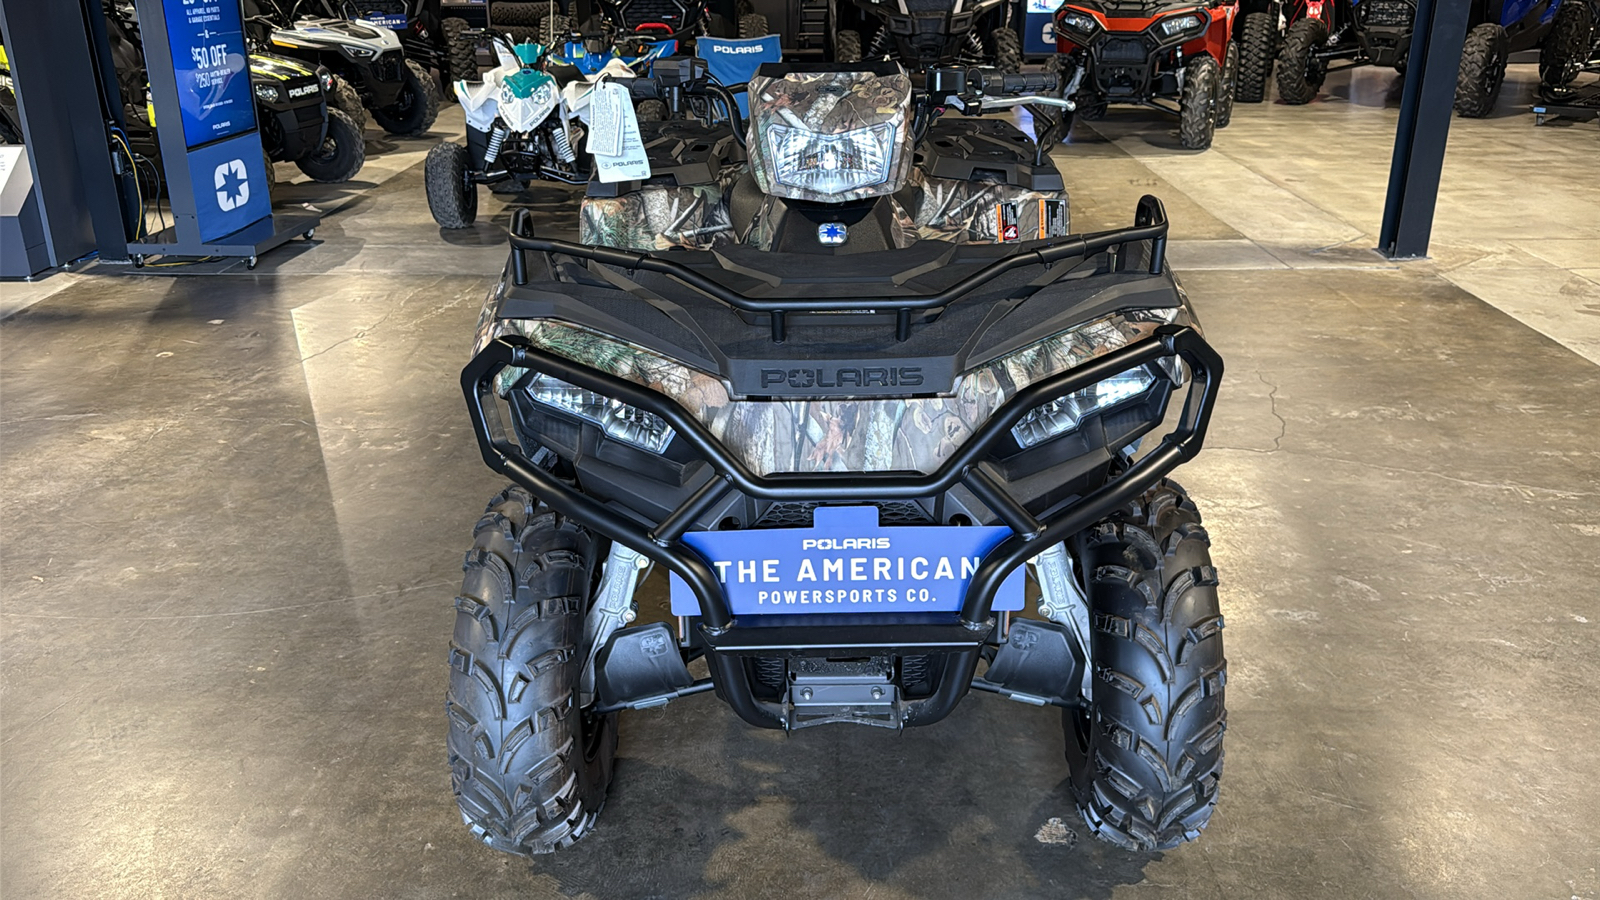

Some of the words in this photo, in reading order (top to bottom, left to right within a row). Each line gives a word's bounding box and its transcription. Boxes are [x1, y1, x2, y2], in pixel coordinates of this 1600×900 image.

[191, 45, 209, 69] $50
[210, 43, 227, 67] OFF
[713, 44, 764, 54] POLARIS
[288, 83, 319, 98] POLARIS
[612, 160, 644, 168] POLARIS
[760, 367, 924, 389] POLARIS
[802, 537, 891, 550] POLARIS
[714, 559, 781, 584] THE
[796, 556, 981, 582] AMERICAN
[758, 588, 898, 605] POWERSPORTS
[906, 588, 937, 603] CO.
